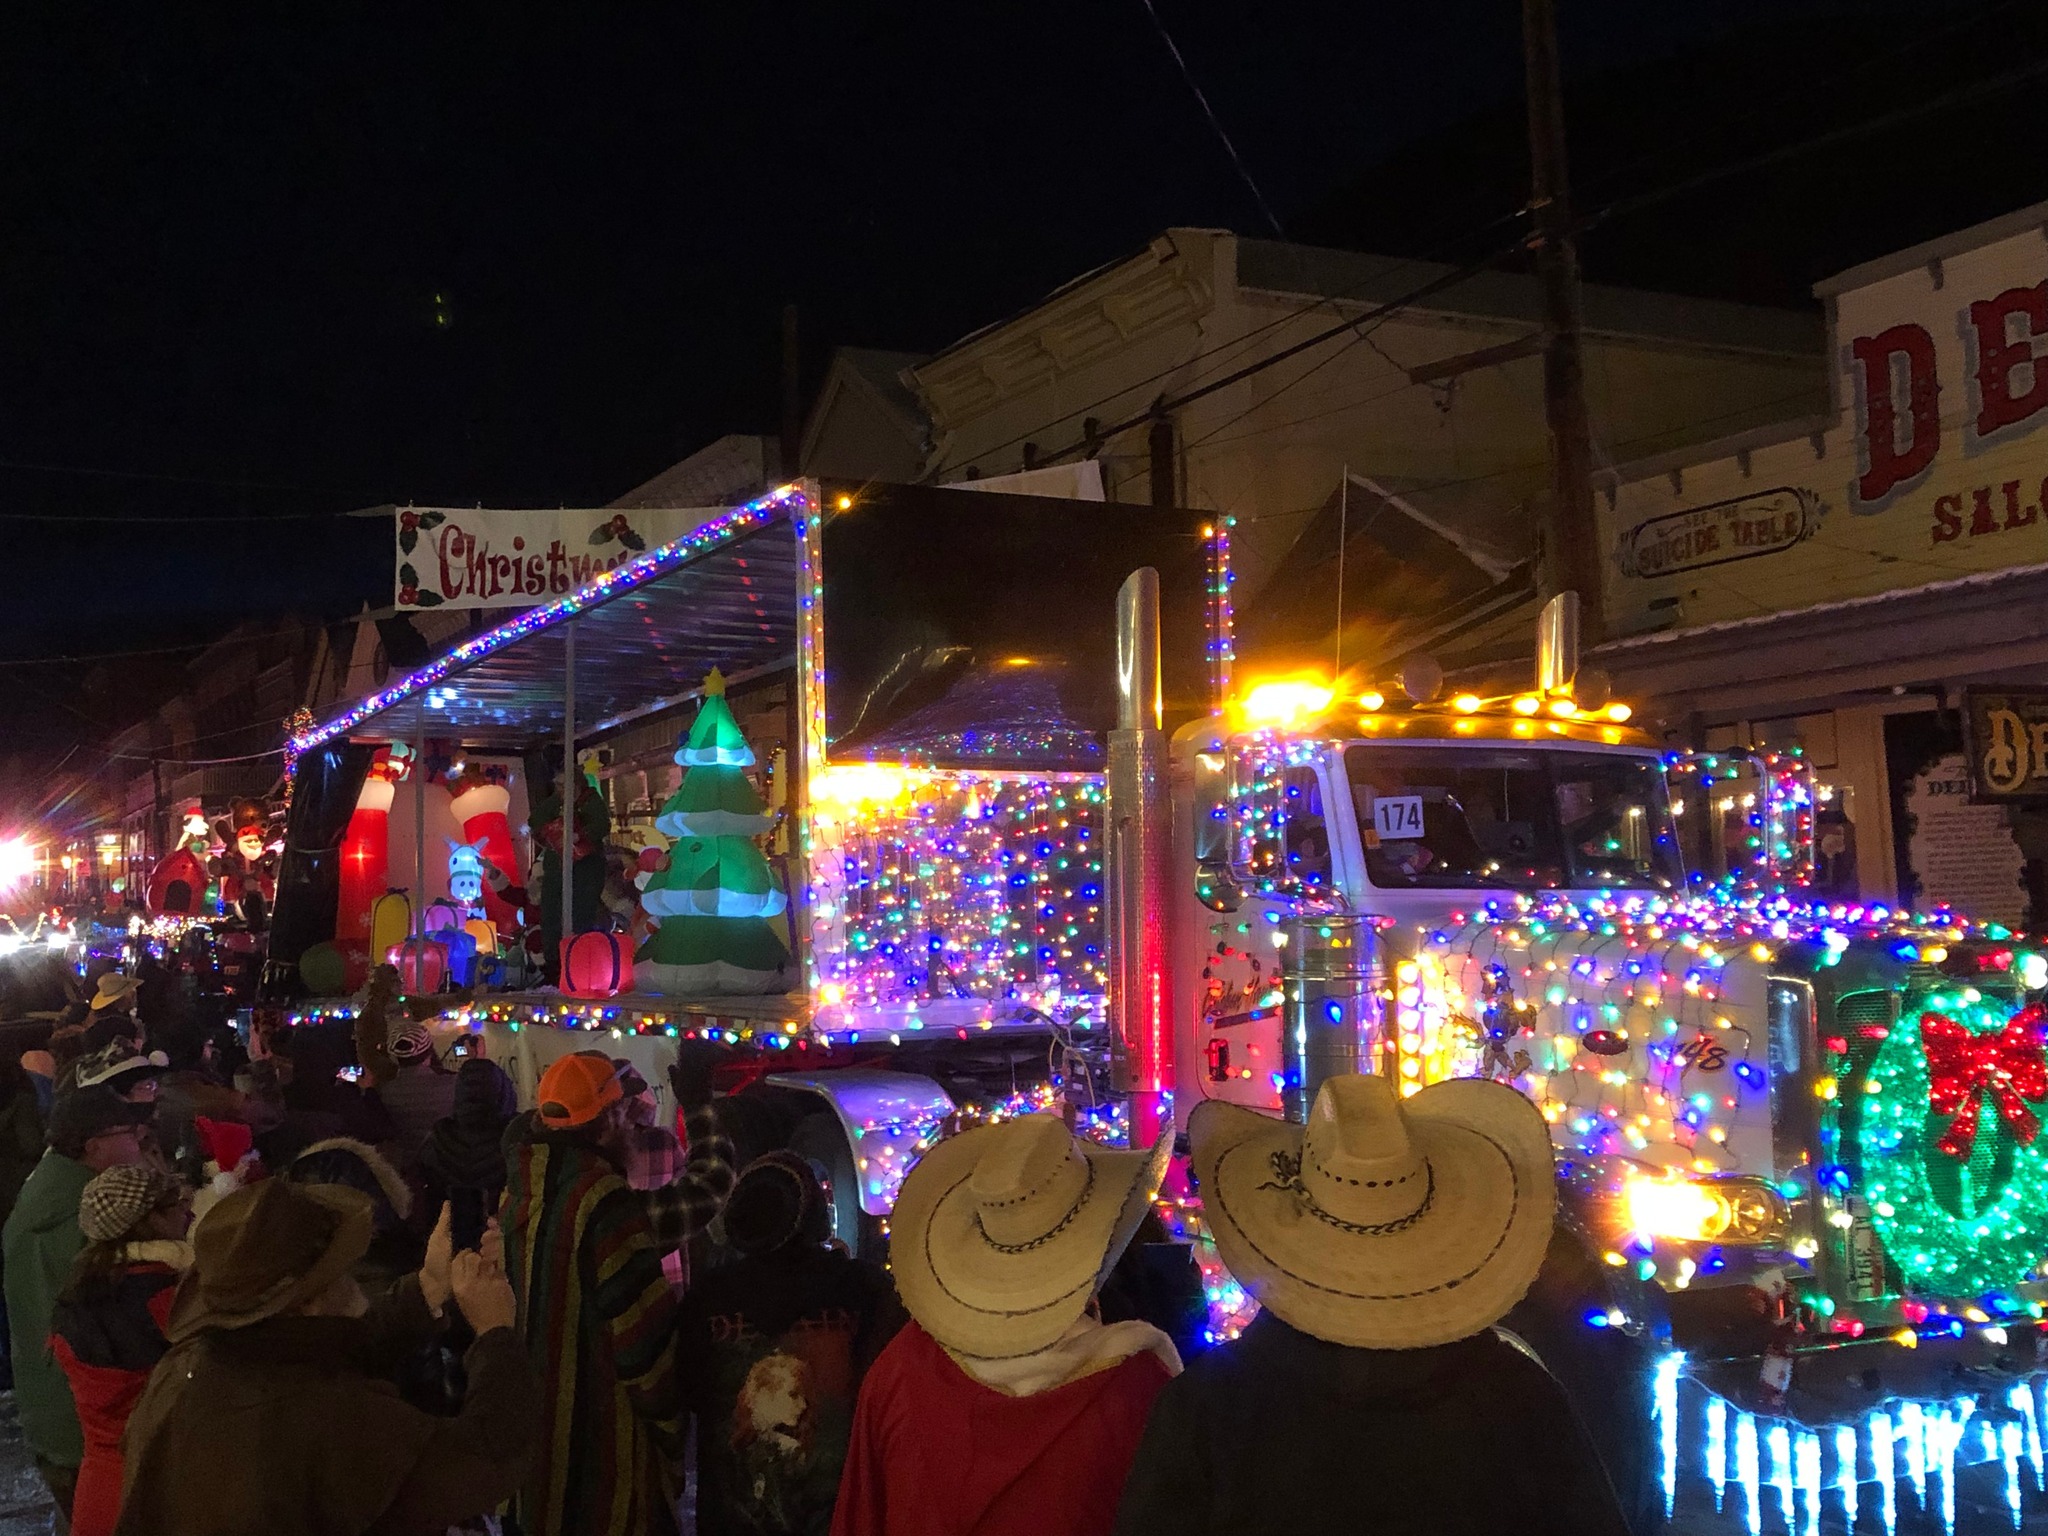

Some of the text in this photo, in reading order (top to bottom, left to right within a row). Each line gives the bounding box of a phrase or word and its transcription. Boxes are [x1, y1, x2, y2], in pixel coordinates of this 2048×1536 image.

[1637, 510, 1798, 570] SUICIDE TABLE
[1931, 477, 2048, 543] SAL
[1381, 802, 1420, 831] 174
